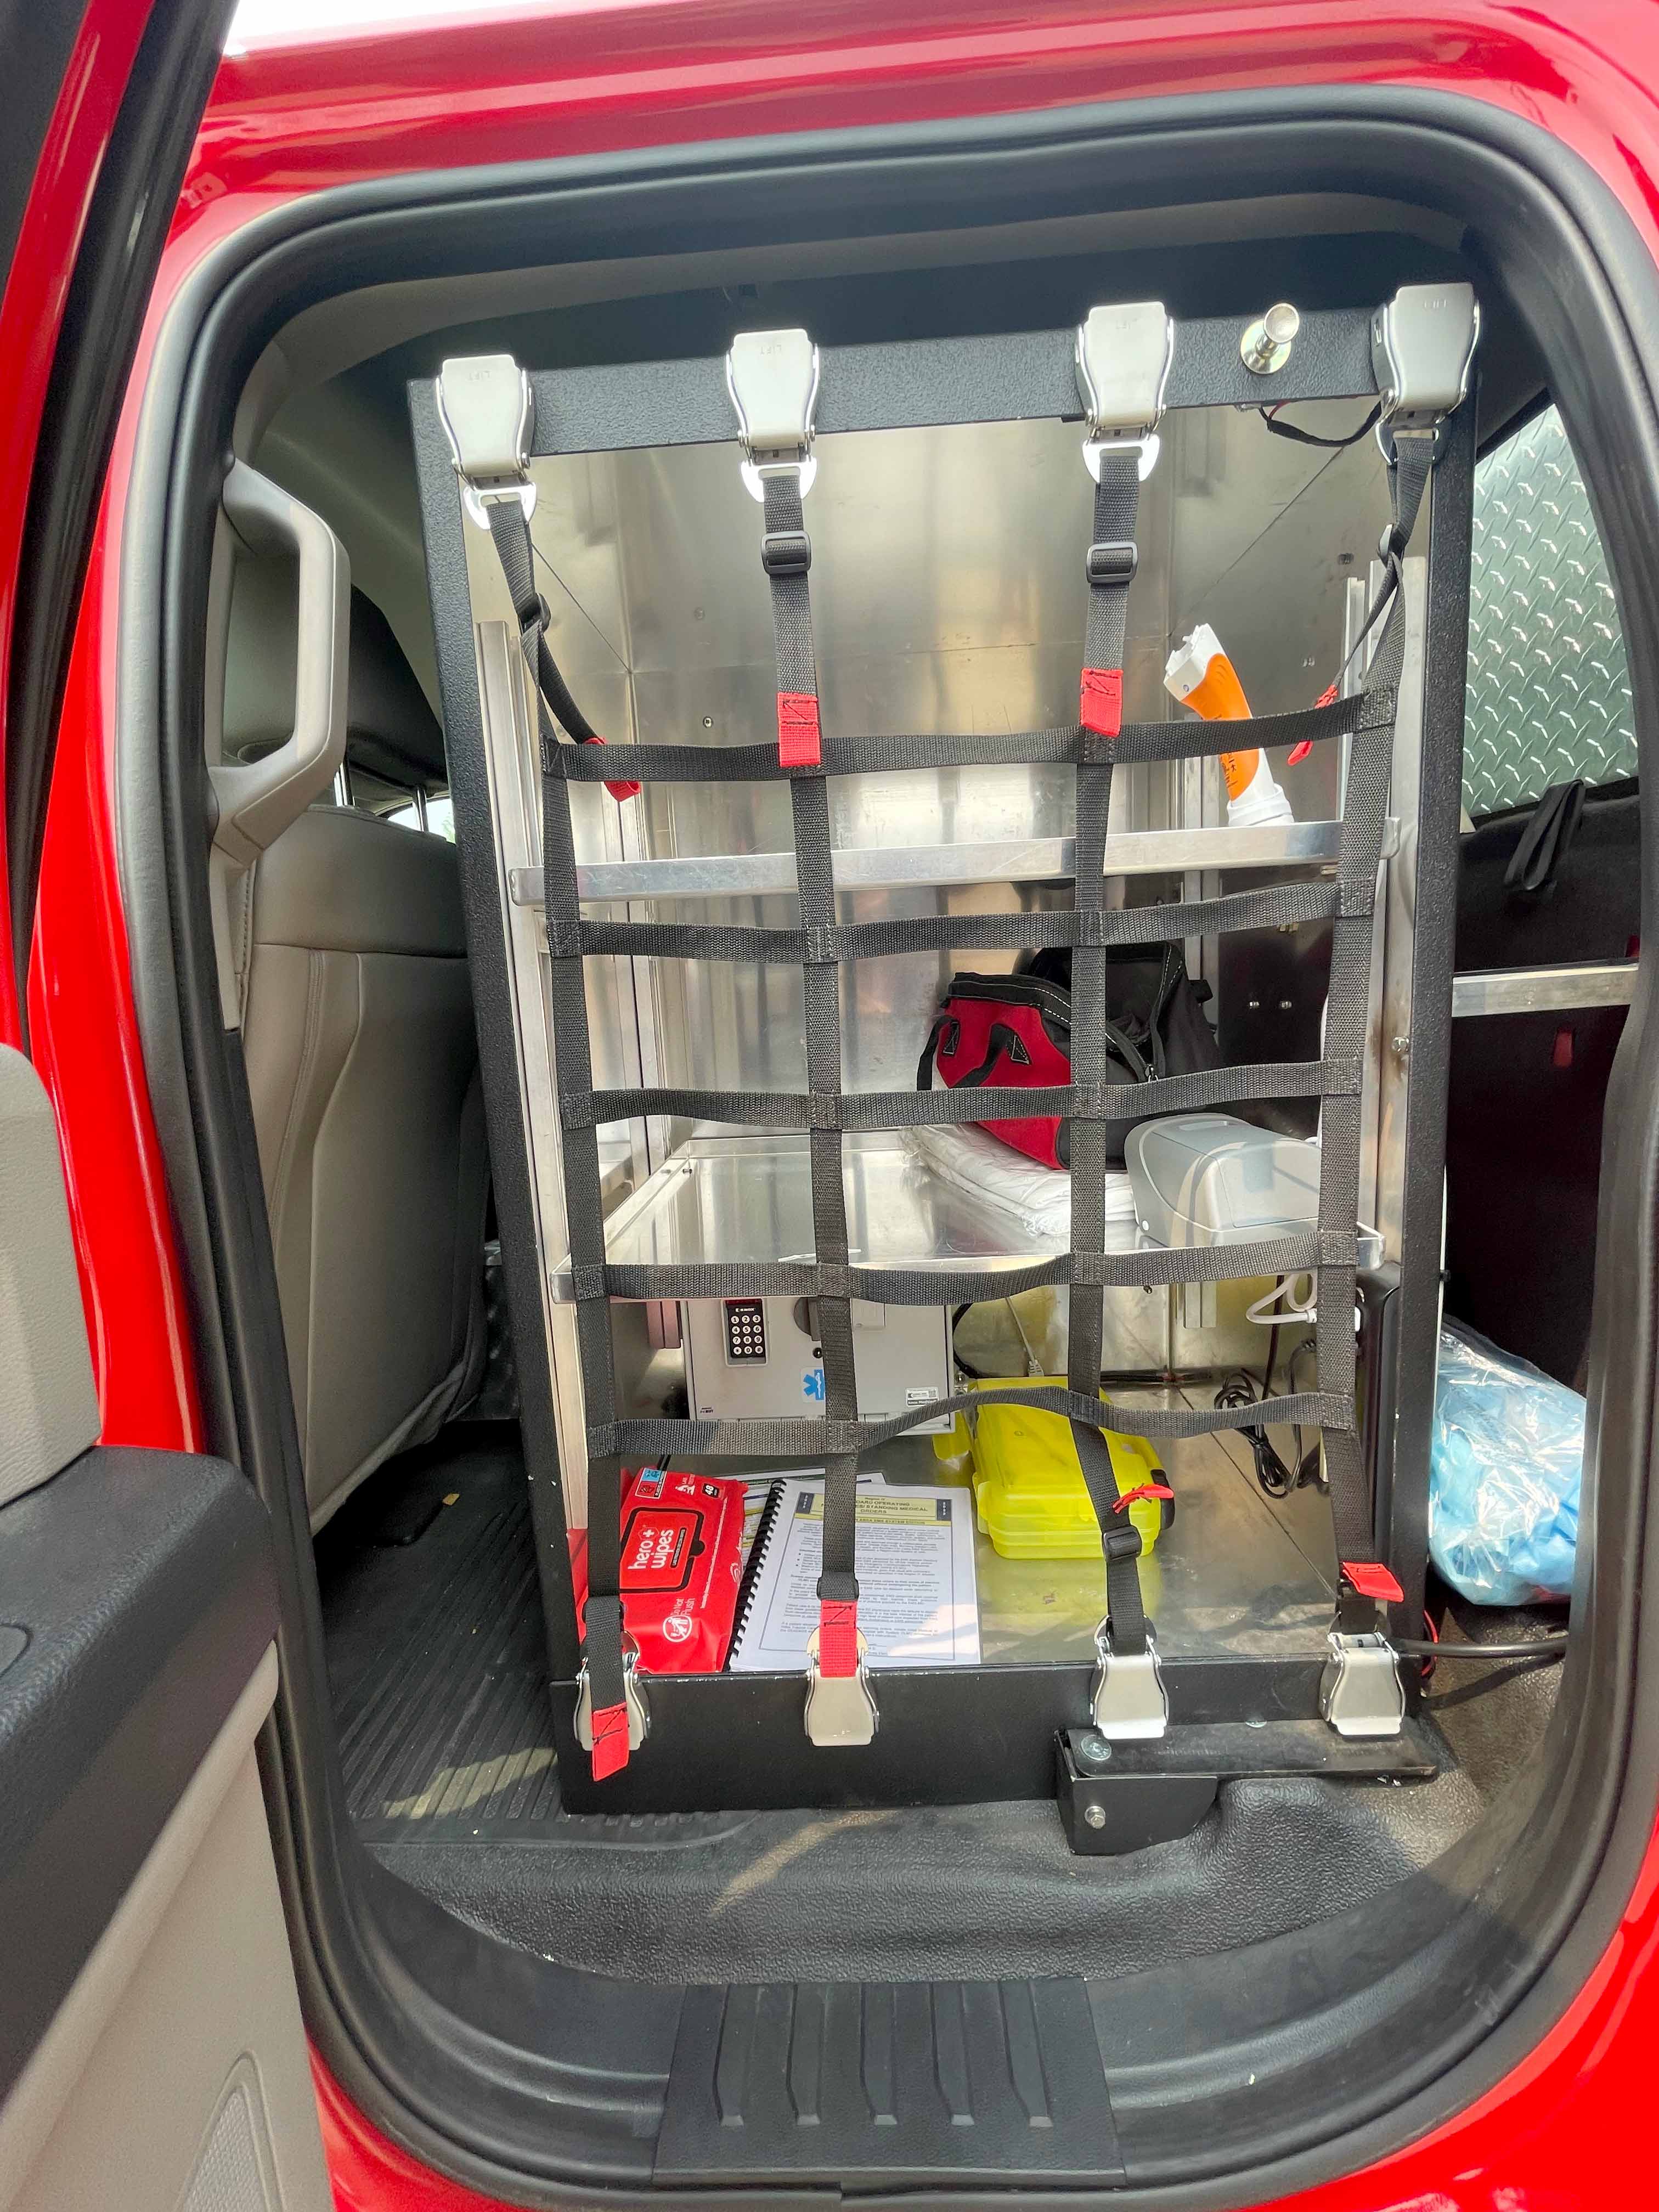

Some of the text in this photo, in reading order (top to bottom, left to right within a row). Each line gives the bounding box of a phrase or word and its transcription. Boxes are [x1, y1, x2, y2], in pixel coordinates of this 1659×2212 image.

[705, 1485, 714, 1495] 48
[651, 1529, 675, 1569] wipes
[673, 1598, 684, 1609] Not
[680, 1598, 695, 1616] Flush
